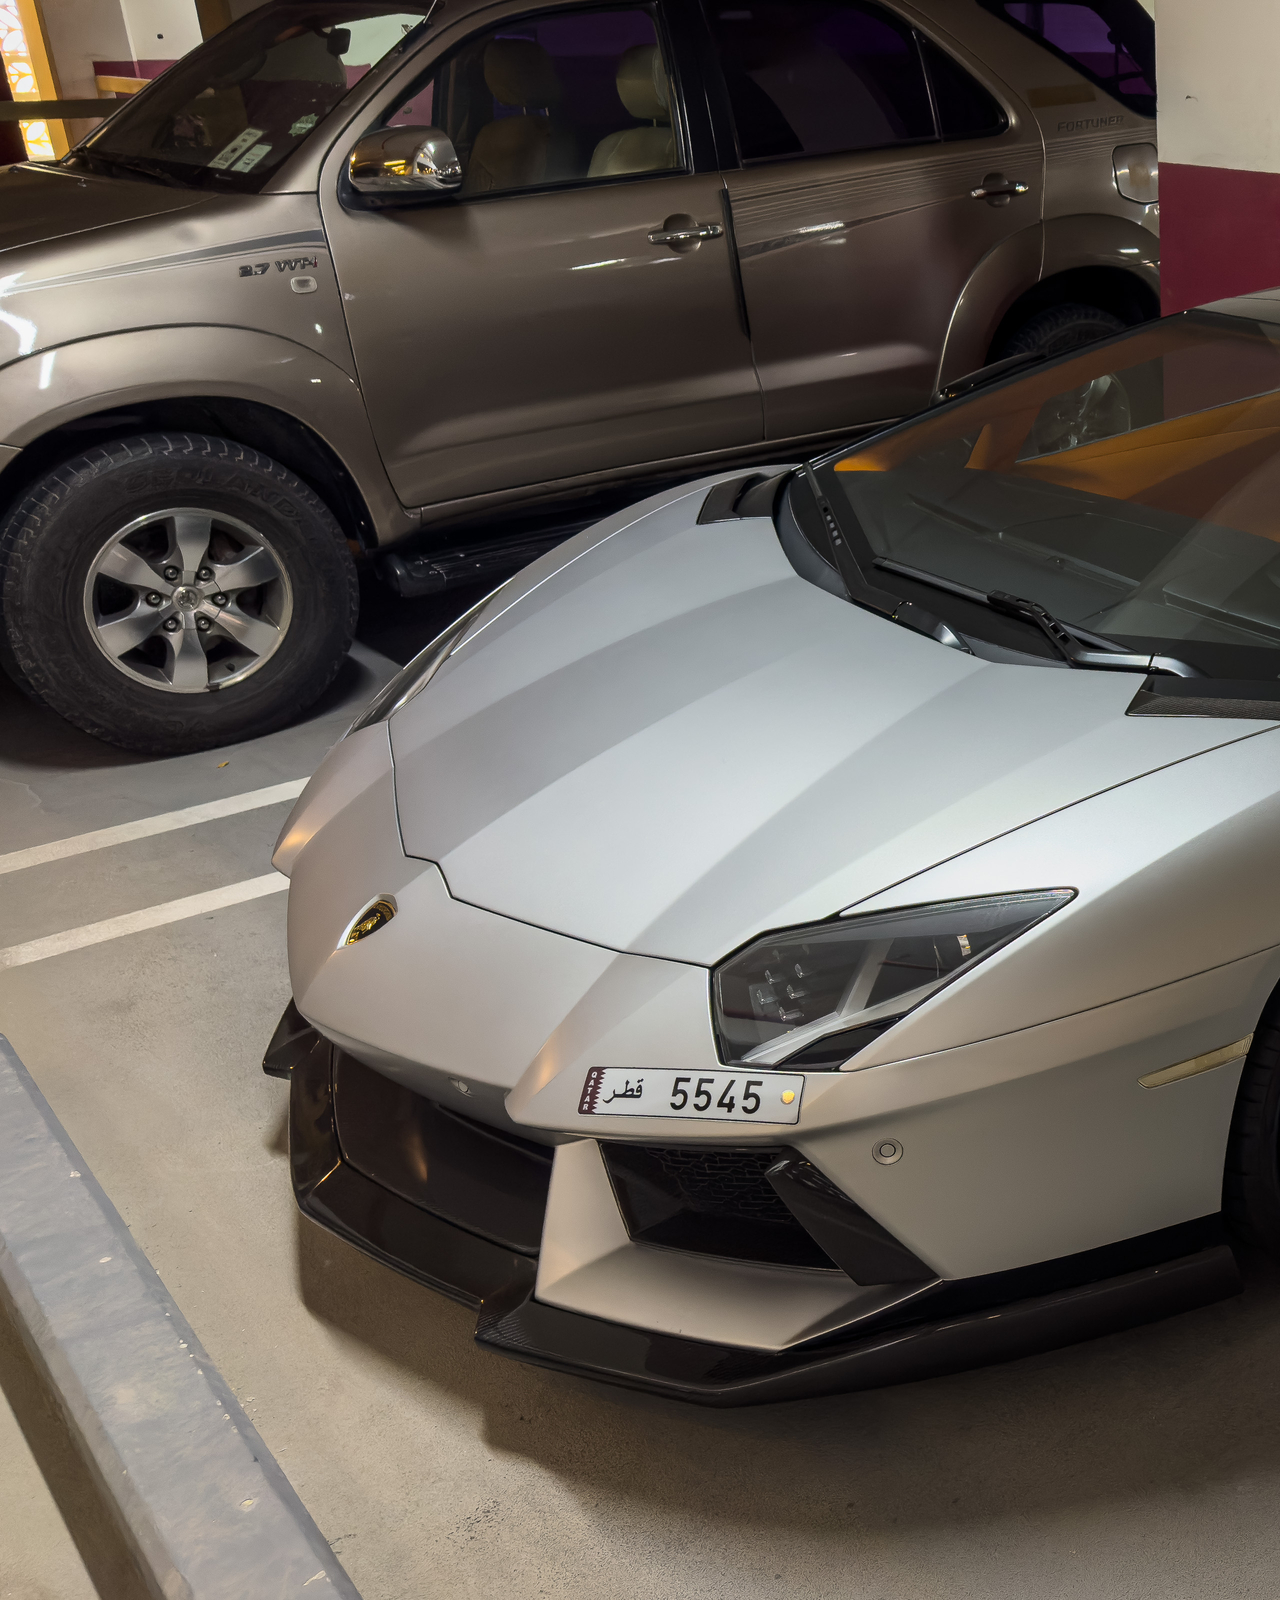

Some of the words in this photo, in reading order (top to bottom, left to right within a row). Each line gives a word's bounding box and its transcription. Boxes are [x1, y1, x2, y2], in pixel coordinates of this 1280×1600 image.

[1057, 114, 1124, 132] FORTUNER
[239, 262, 271, 278] 2.7
[581, 1071, 598, 1111] QATAR
[602, 1078, 644, 1103] قطر
[670, 1076, 763, 1114] 5545
